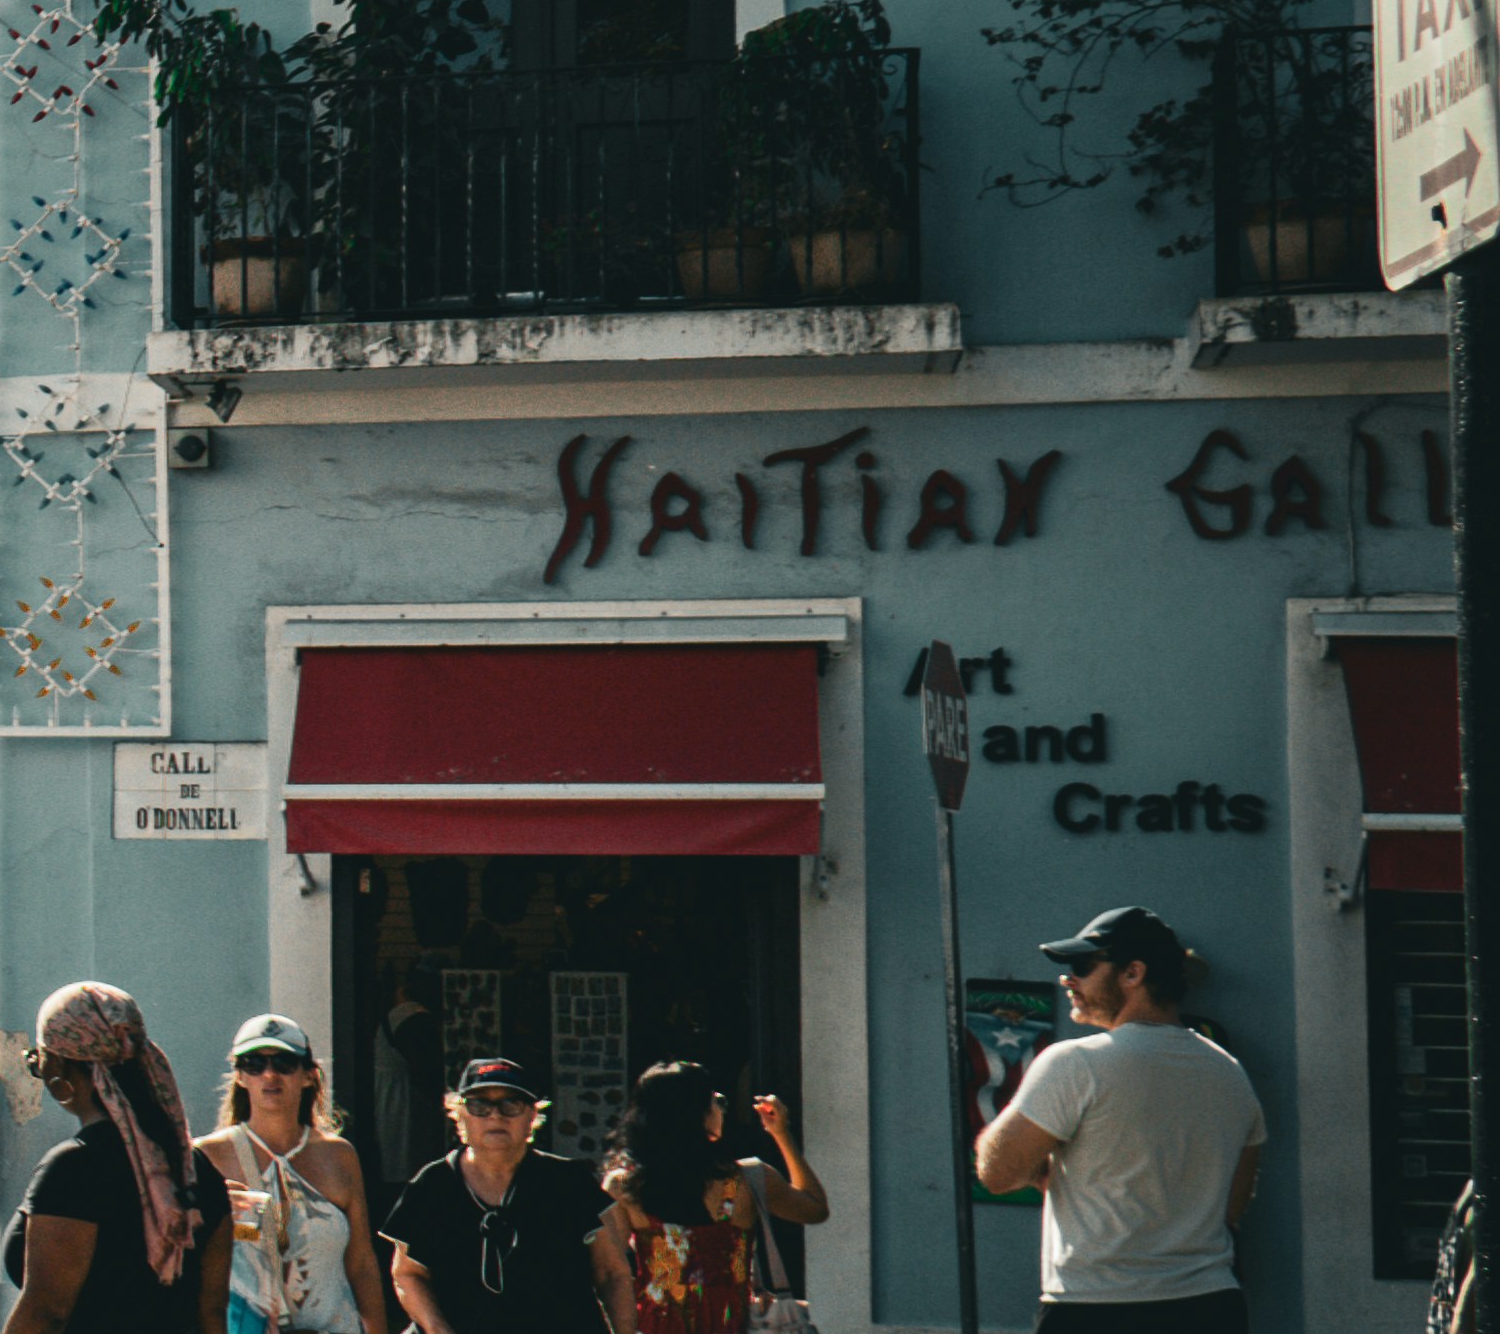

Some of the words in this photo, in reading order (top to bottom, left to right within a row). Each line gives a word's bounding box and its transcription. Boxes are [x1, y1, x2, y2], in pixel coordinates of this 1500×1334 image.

[926, 688, 968, 763] PARE
[981, 713, 1109, 764] and
[179, 783, 200, 799] DE
[1052, 779, 1268, 834] Crafts
